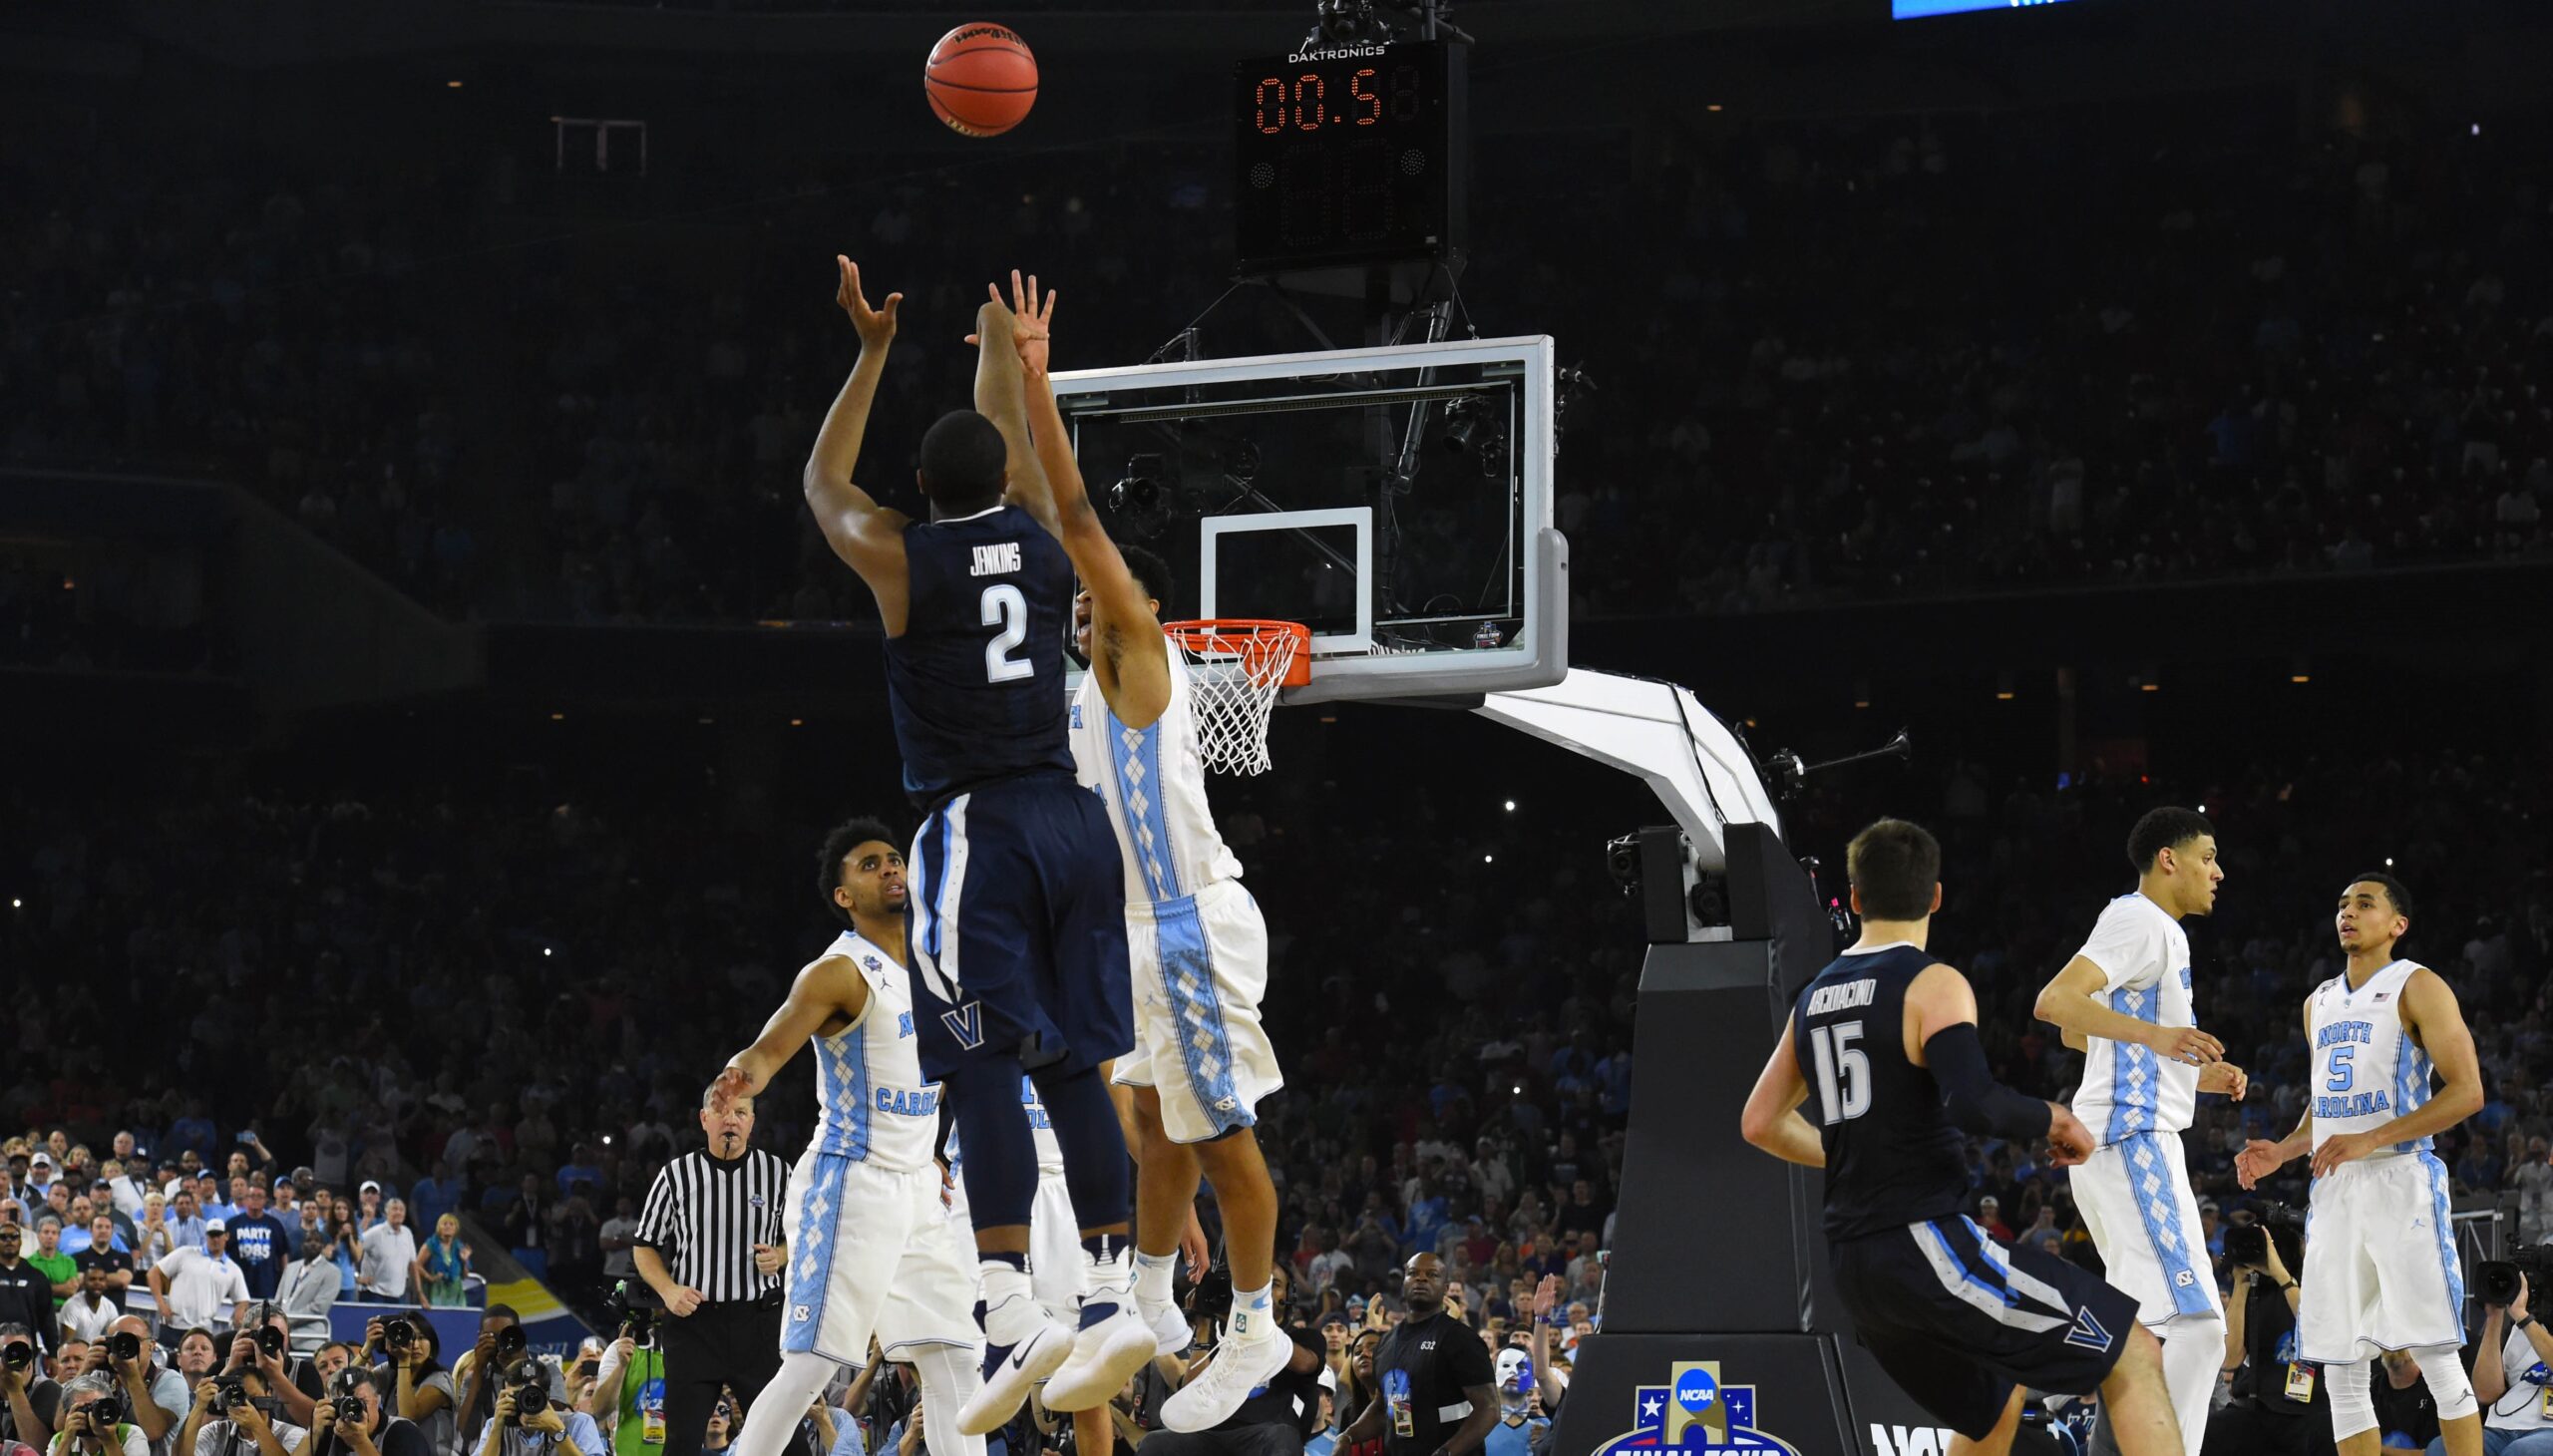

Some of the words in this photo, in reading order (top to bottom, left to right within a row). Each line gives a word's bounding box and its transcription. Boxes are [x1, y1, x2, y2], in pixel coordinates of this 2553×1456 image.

[1288, 46, 1385, 63] DAKTRONICS
[1257, 69, 1381, 134] 00.5
[970, 542, 1021, 576] JENKINS
[980, 583, 1034, 683] 2
[1807, 978, 1877, 1017] ARCIDIACONO
[940, 1000, 985, 1051] V
[2317, 1021, 2372, 1050] NORTH
[1810, 1020, 1871, 1126] 15
[2327, 1045, 2355, 1092] 5
[2312, 1090, 2389, 1119] AROLINA
[236, 1228, 271, 1240] PARTY
[238, 1244, 270, 1260] 1985
[1420, 1340, 1436, 1350] 632
[2063, 1304, 2113, 1353] V
[1679, 1389, 1714, 1401] NCAA
